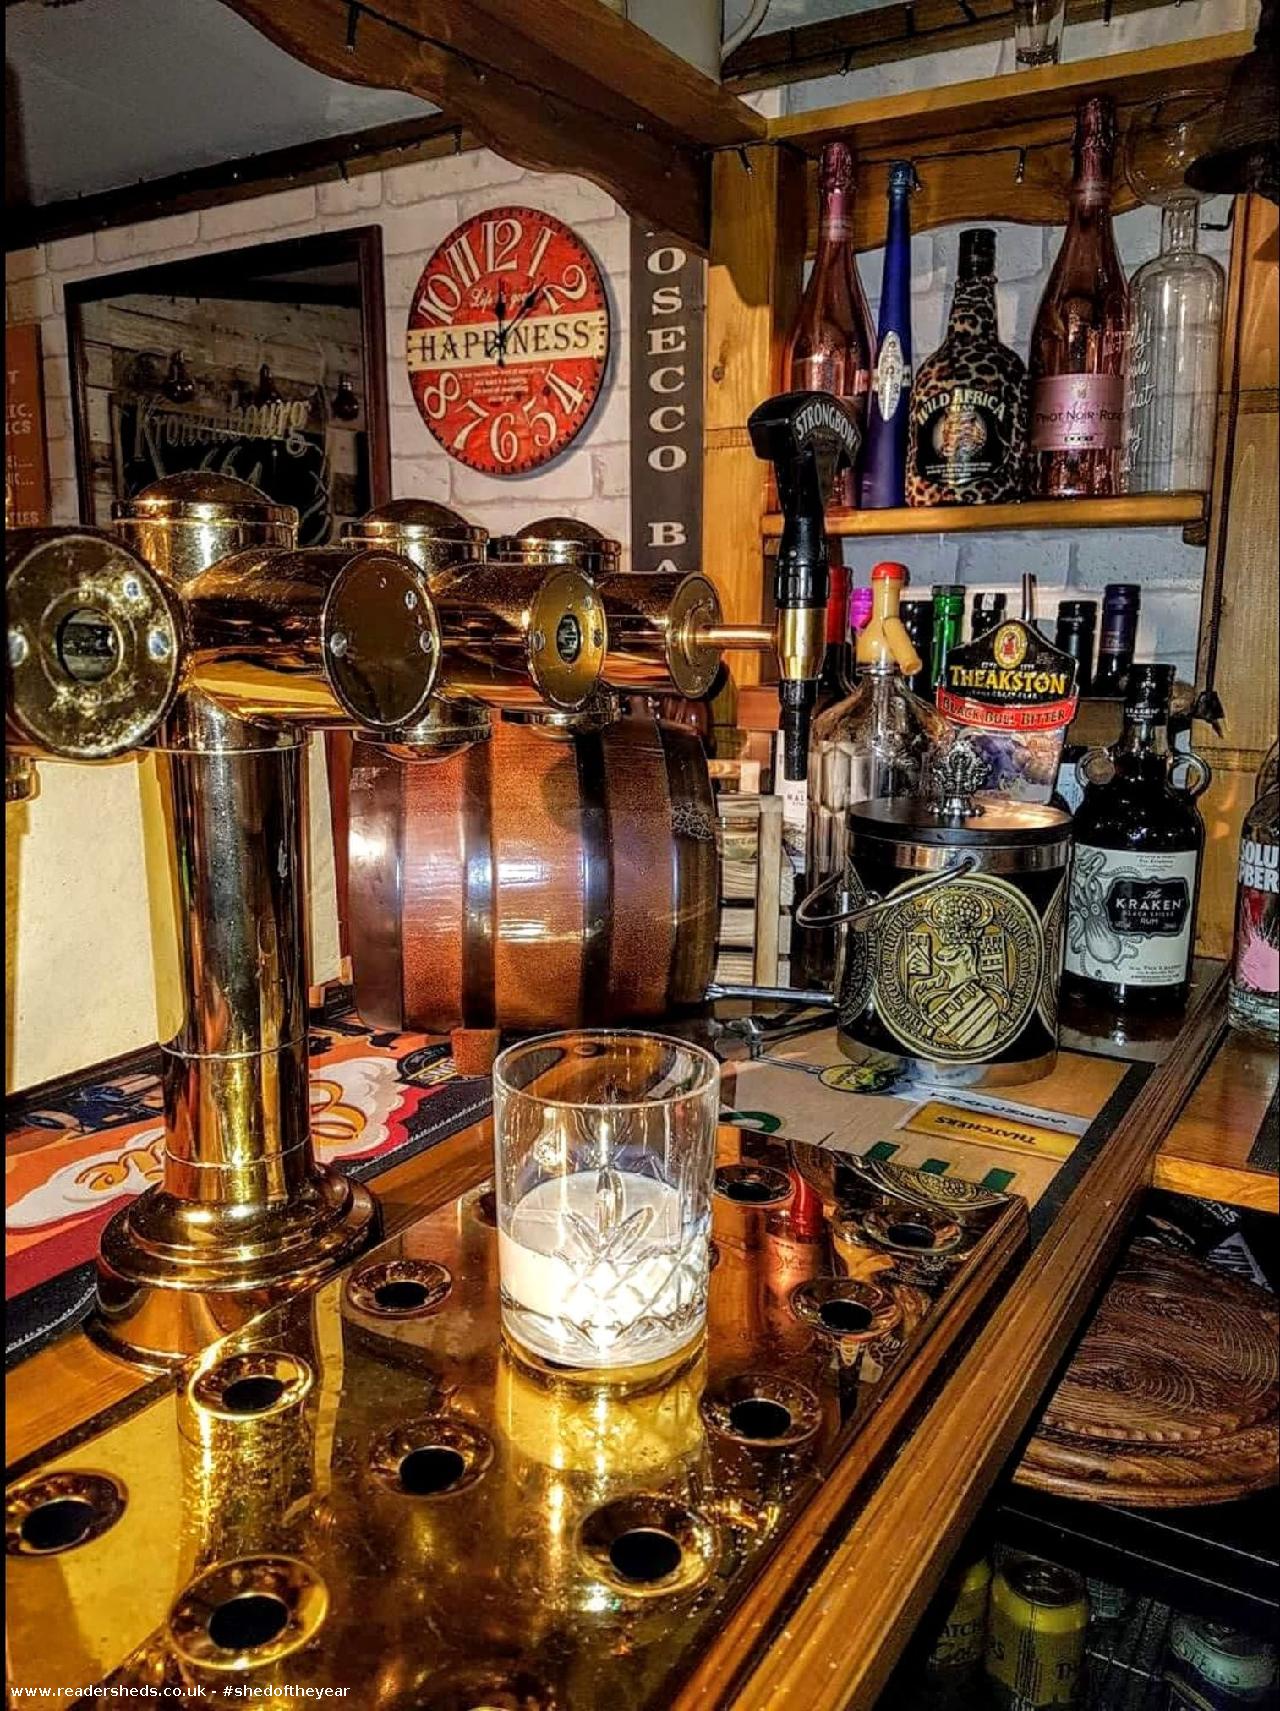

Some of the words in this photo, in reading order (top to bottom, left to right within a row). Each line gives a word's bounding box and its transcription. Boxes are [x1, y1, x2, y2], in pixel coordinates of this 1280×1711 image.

[480, 217, 524, 273] 12
[417, 274, 463, 325] 10
[540, 264, 588, 315] 2
[646, 232, 687, 472] OSECCO
[423, 371, 462, 420] 8
[545, 363, 586, 416] 4
[917, 392, 950, 425] WILD
[953, 387, 1006, 422] AFRICA
[452, 400, 491, 450] 7
[490, 412, 519, 463] 6
[522, 396, 558, 447] 5
[795, 402, 858, 450] STRONGBOW
[949, 664, 1068, 694] THEAKSTON
[943, 697, 982, 720] BLACK
[985, 711, 1017, 725] BULL
[1019, 709, 1066, 725] BITTER
[1116, 898, 1182, 911] KRAKEN
[934, 1115, 1037, 1146] THATCHERS
